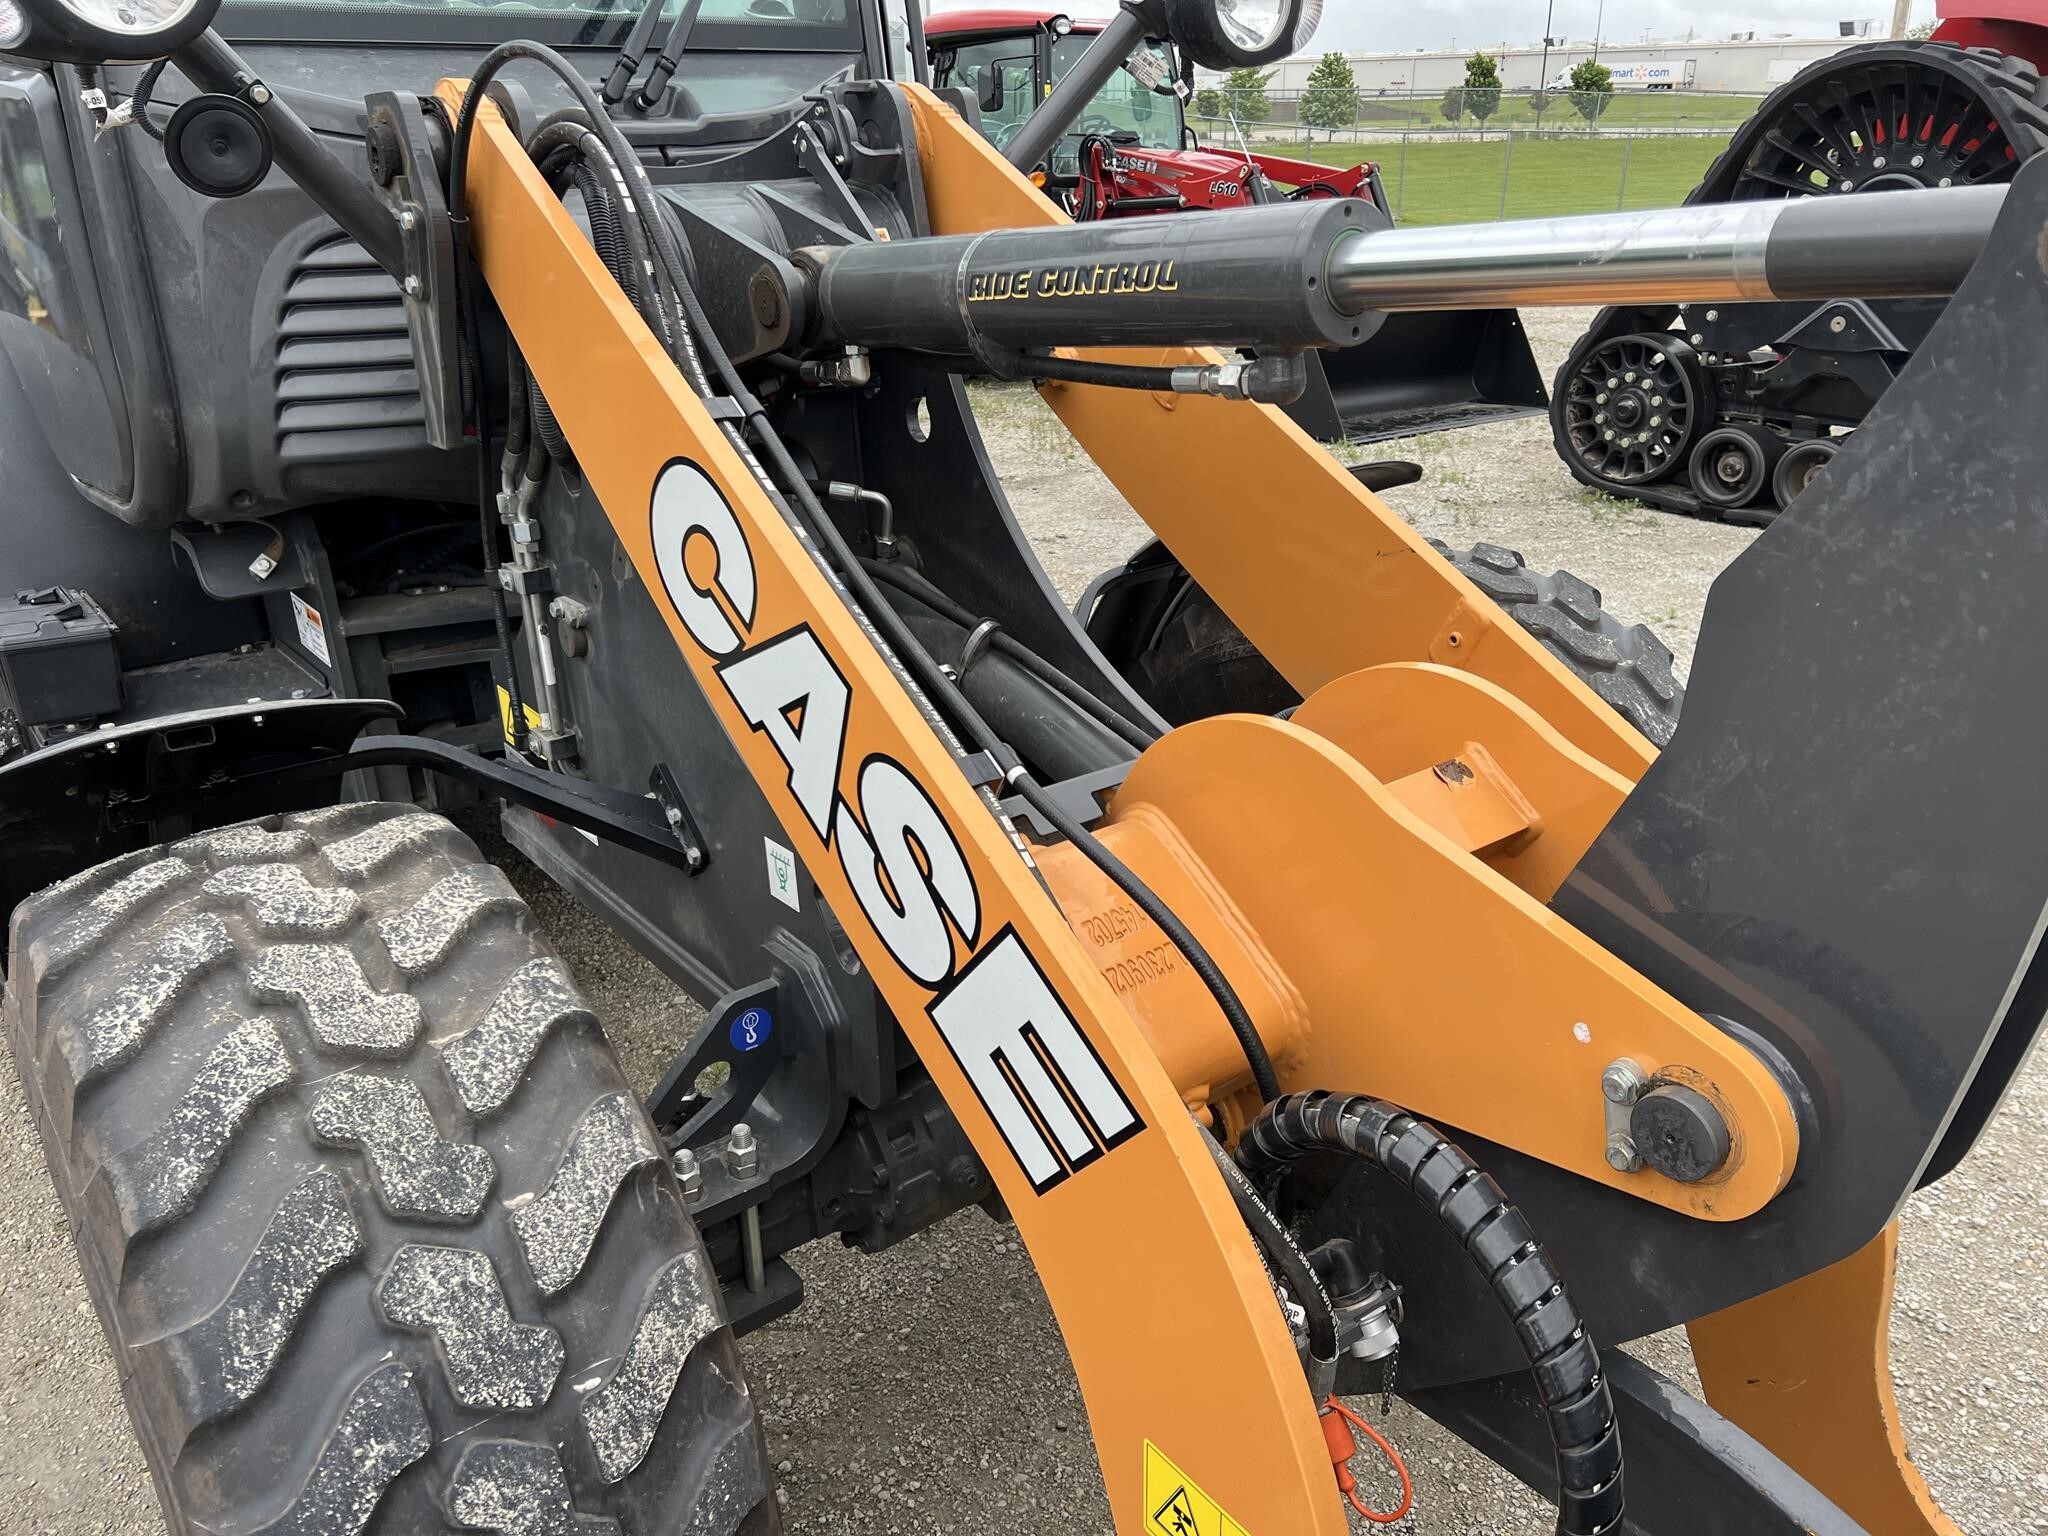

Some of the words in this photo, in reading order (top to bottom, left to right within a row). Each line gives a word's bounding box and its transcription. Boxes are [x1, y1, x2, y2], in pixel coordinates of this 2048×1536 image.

[1612, 69, 1633, 77] mart
[1649, 69, 1669, 77] com
[1209, 181, 1238, 197] L610
[969, 270, 1032, 301] RIDE
[1037, 260, 1178, 297] CONTROL
[648, 456, 1147, 1197] CASE
[1101, 942, 1188, 995] L230902
[1231, 1169, 1244, 1184] DN
[1243, 1183, 1254, 1195] 12
[1251, 1194, 1266, 1212] mm
[1265, 1211, 1282, 1233] Max.
[1283, 1231, 1298, 1253] W.P.
[1298, 1252, 1311, 1269] 350
[1308, 1268, 1320, 1285] Bar
